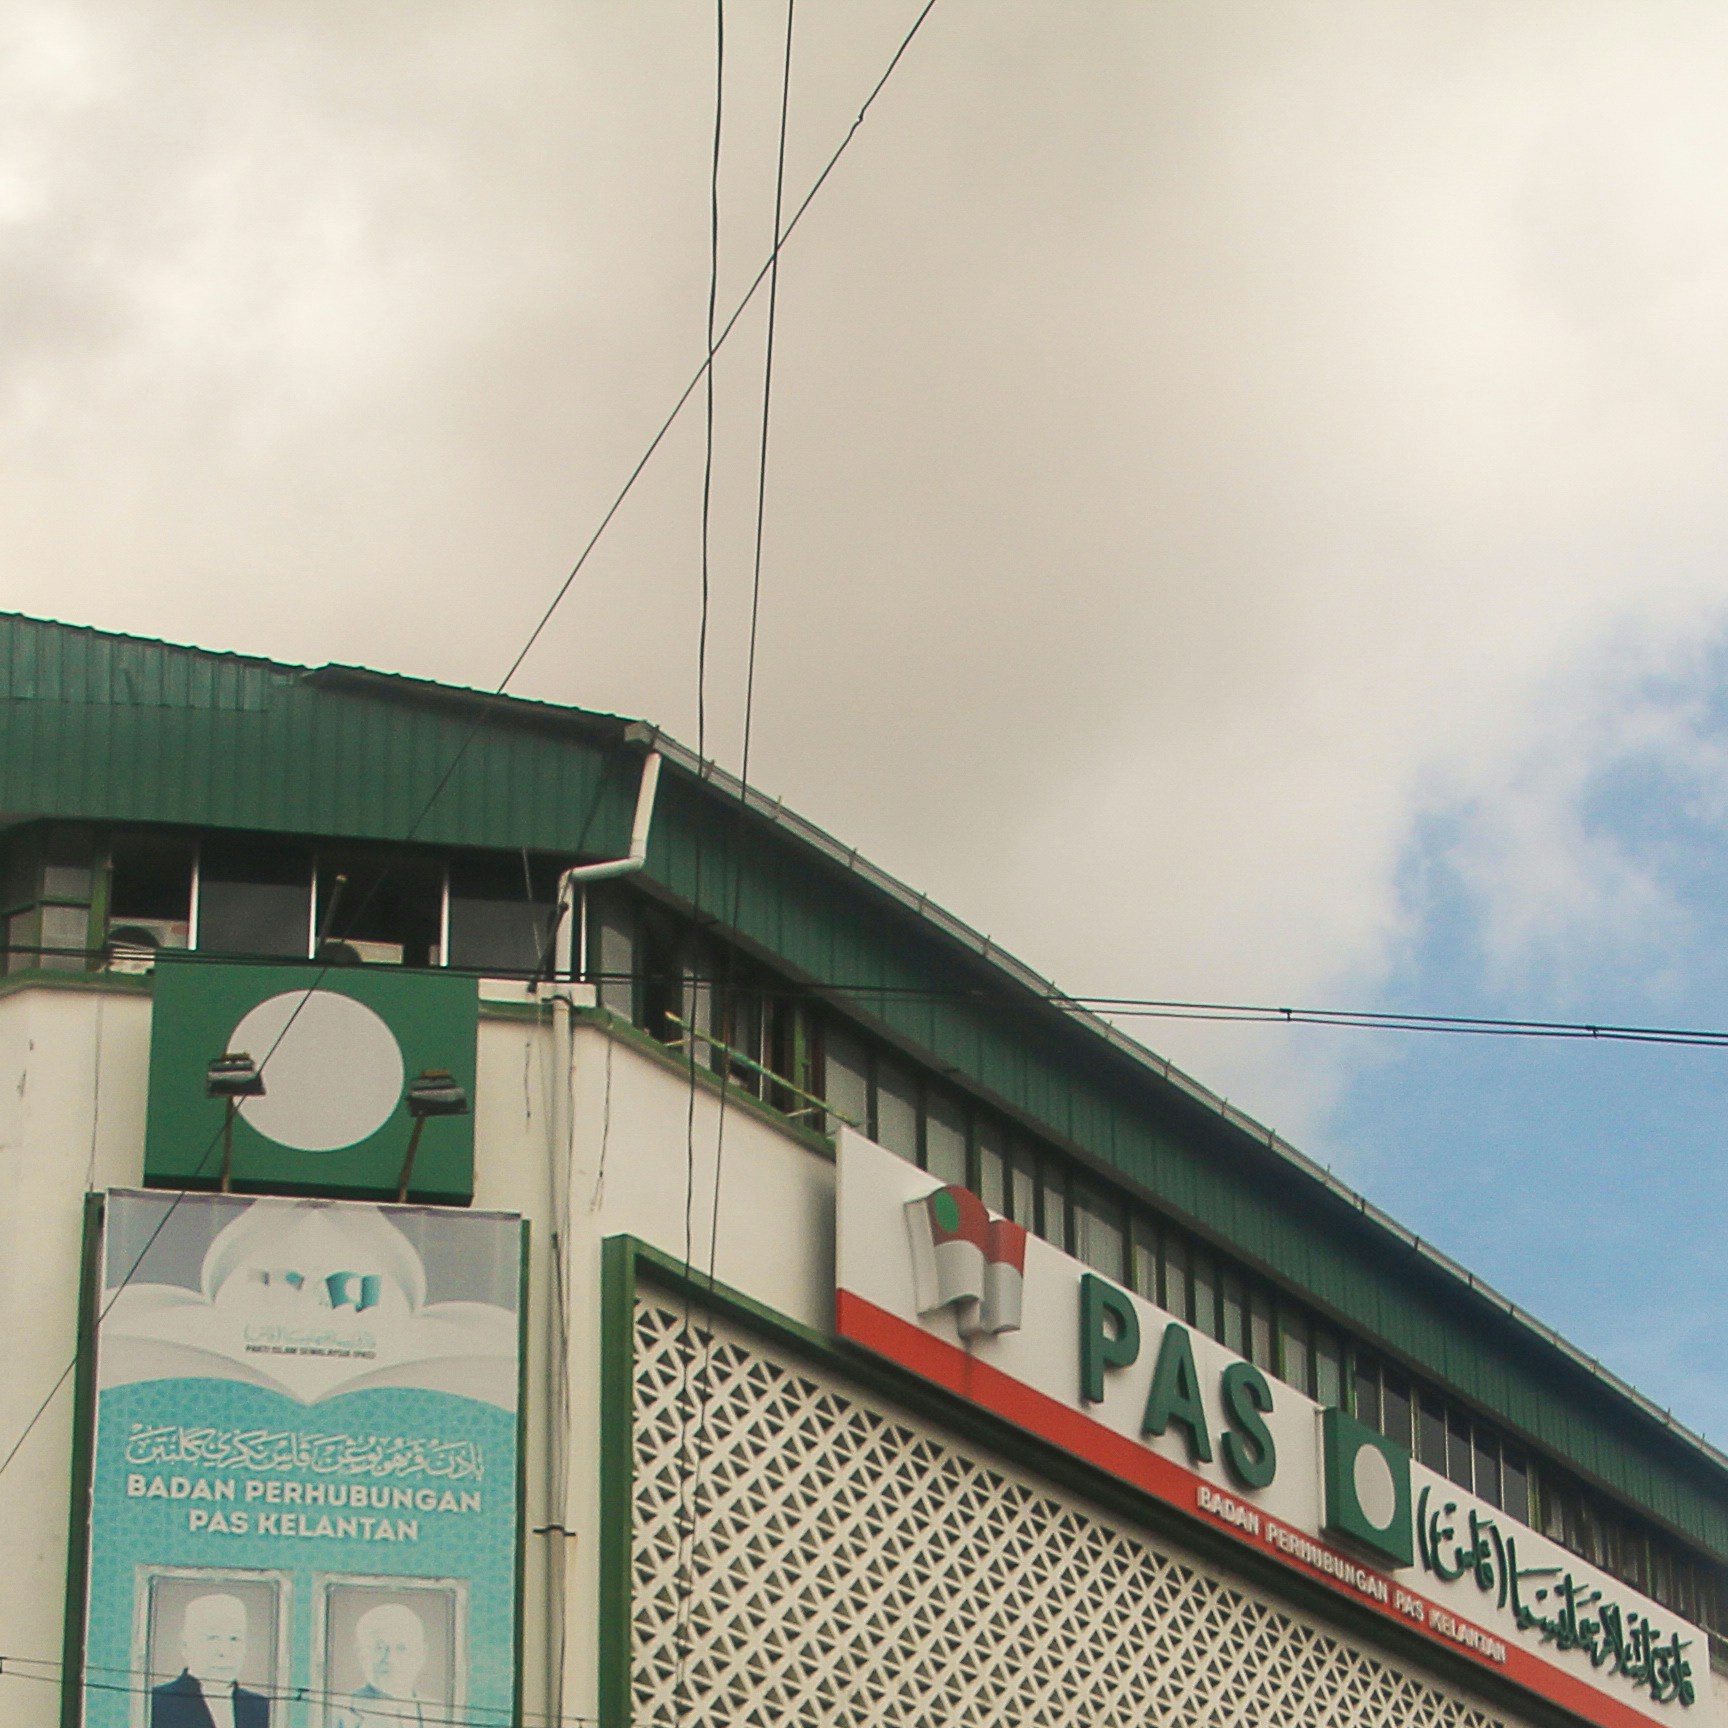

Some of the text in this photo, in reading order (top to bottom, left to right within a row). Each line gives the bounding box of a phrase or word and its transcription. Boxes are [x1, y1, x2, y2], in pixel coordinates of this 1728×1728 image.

[1080, 1271, 1277, 1490] PAS
[127, 1473, 481, 1513] BADAN PERHUBUNGAN
[189, 1509, 418, 1541] PAS KELANTAN
[1196, 1486, 1507, 1663] BADAN PERHUBUNGAN PAS KELANTAN
